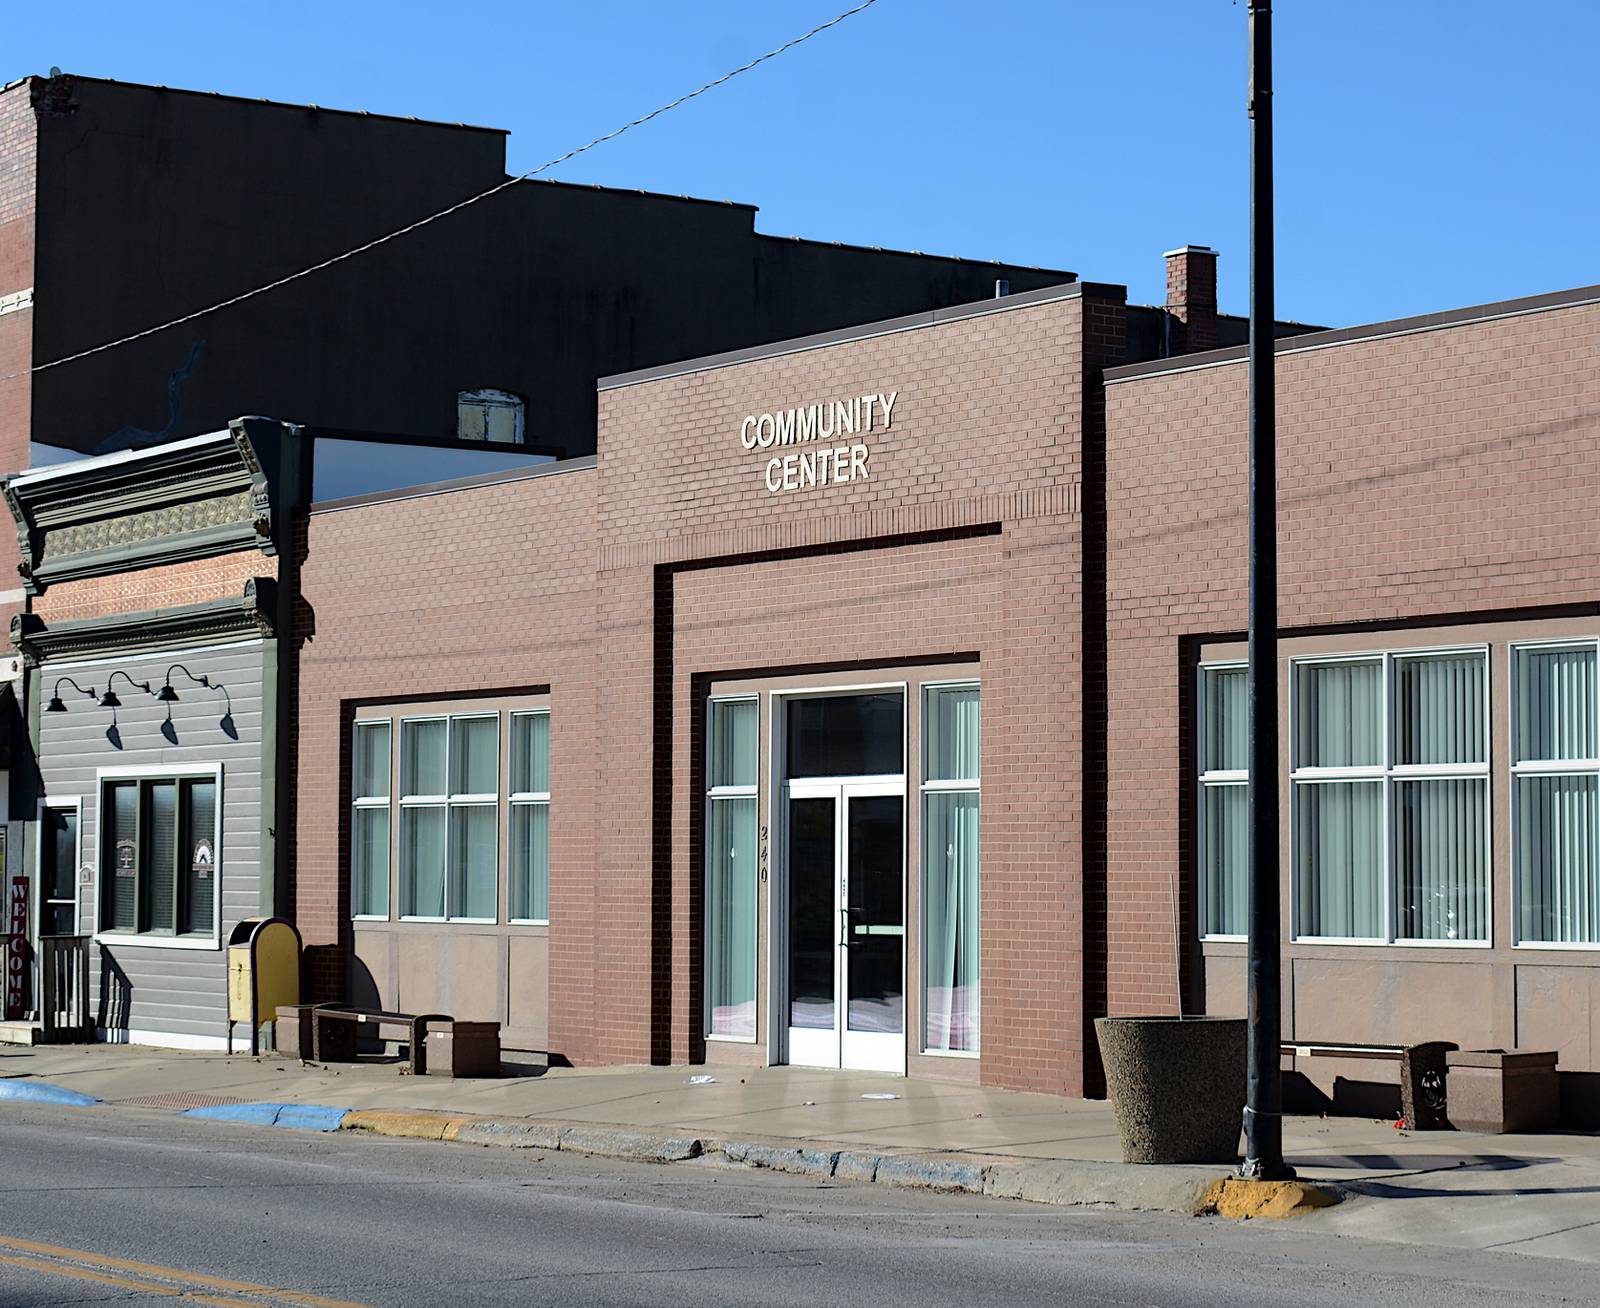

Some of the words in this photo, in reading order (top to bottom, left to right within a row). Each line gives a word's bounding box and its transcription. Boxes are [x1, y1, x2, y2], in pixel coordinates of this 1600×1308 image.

[741, 391, 898, 450] COMMUNITY
[765, 444, 870, 492] CENTER
[760, 826, 768, 884] 240
[9, 884, 28, 1007] WELCOME
